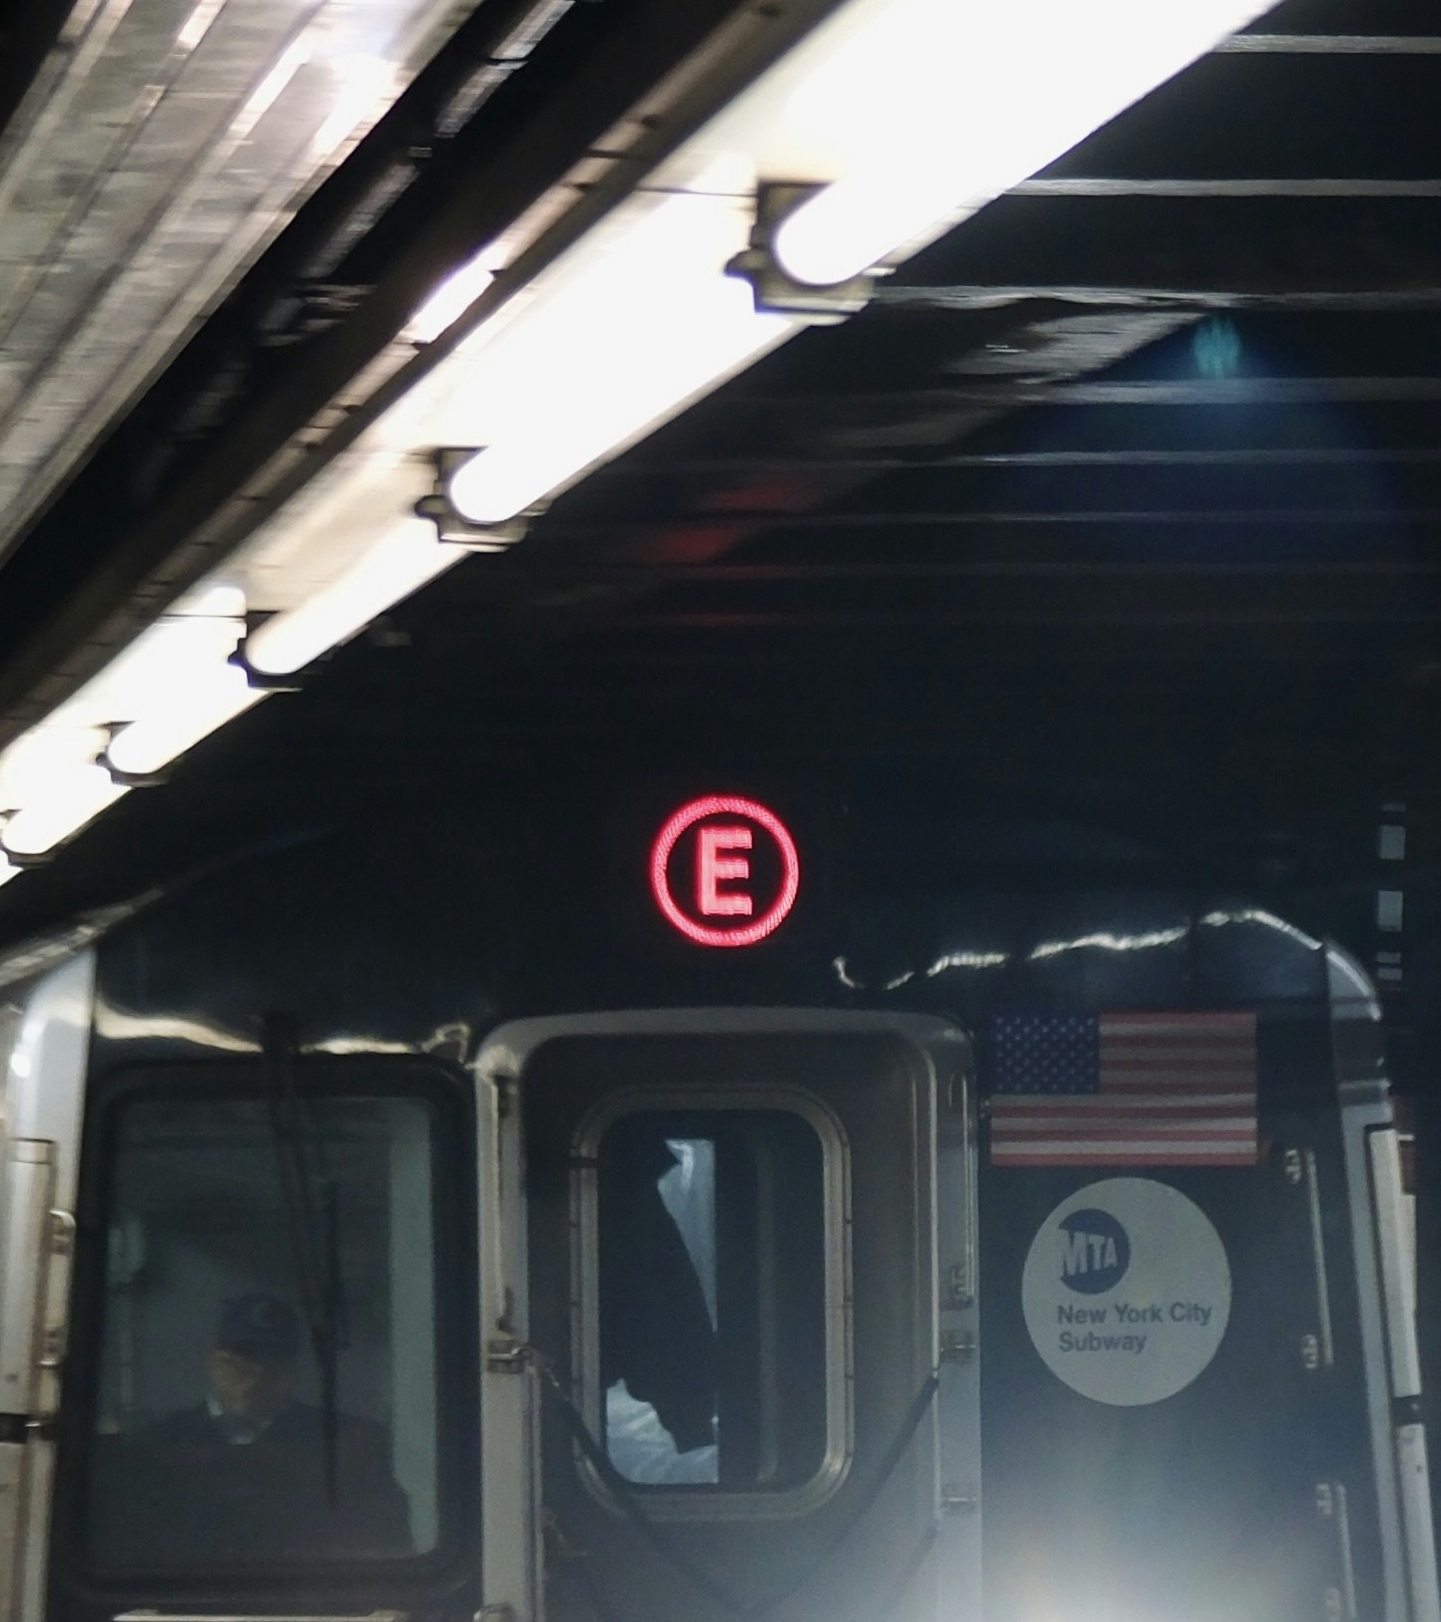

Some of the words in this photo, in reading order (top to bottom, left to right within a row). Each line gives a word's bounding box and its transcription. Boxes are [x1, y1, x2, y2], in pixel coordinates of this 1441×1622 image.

[698, 828, 753, 915] E
[1059, 1228, 1118, 1277] MTA
[1059, 1305, 1106, 1324] New
[1115, 1303, 1163, 1323] York
[1170, 1302, 1212, 1326] City
[1059, 1331, 1147, 1354] Subway
